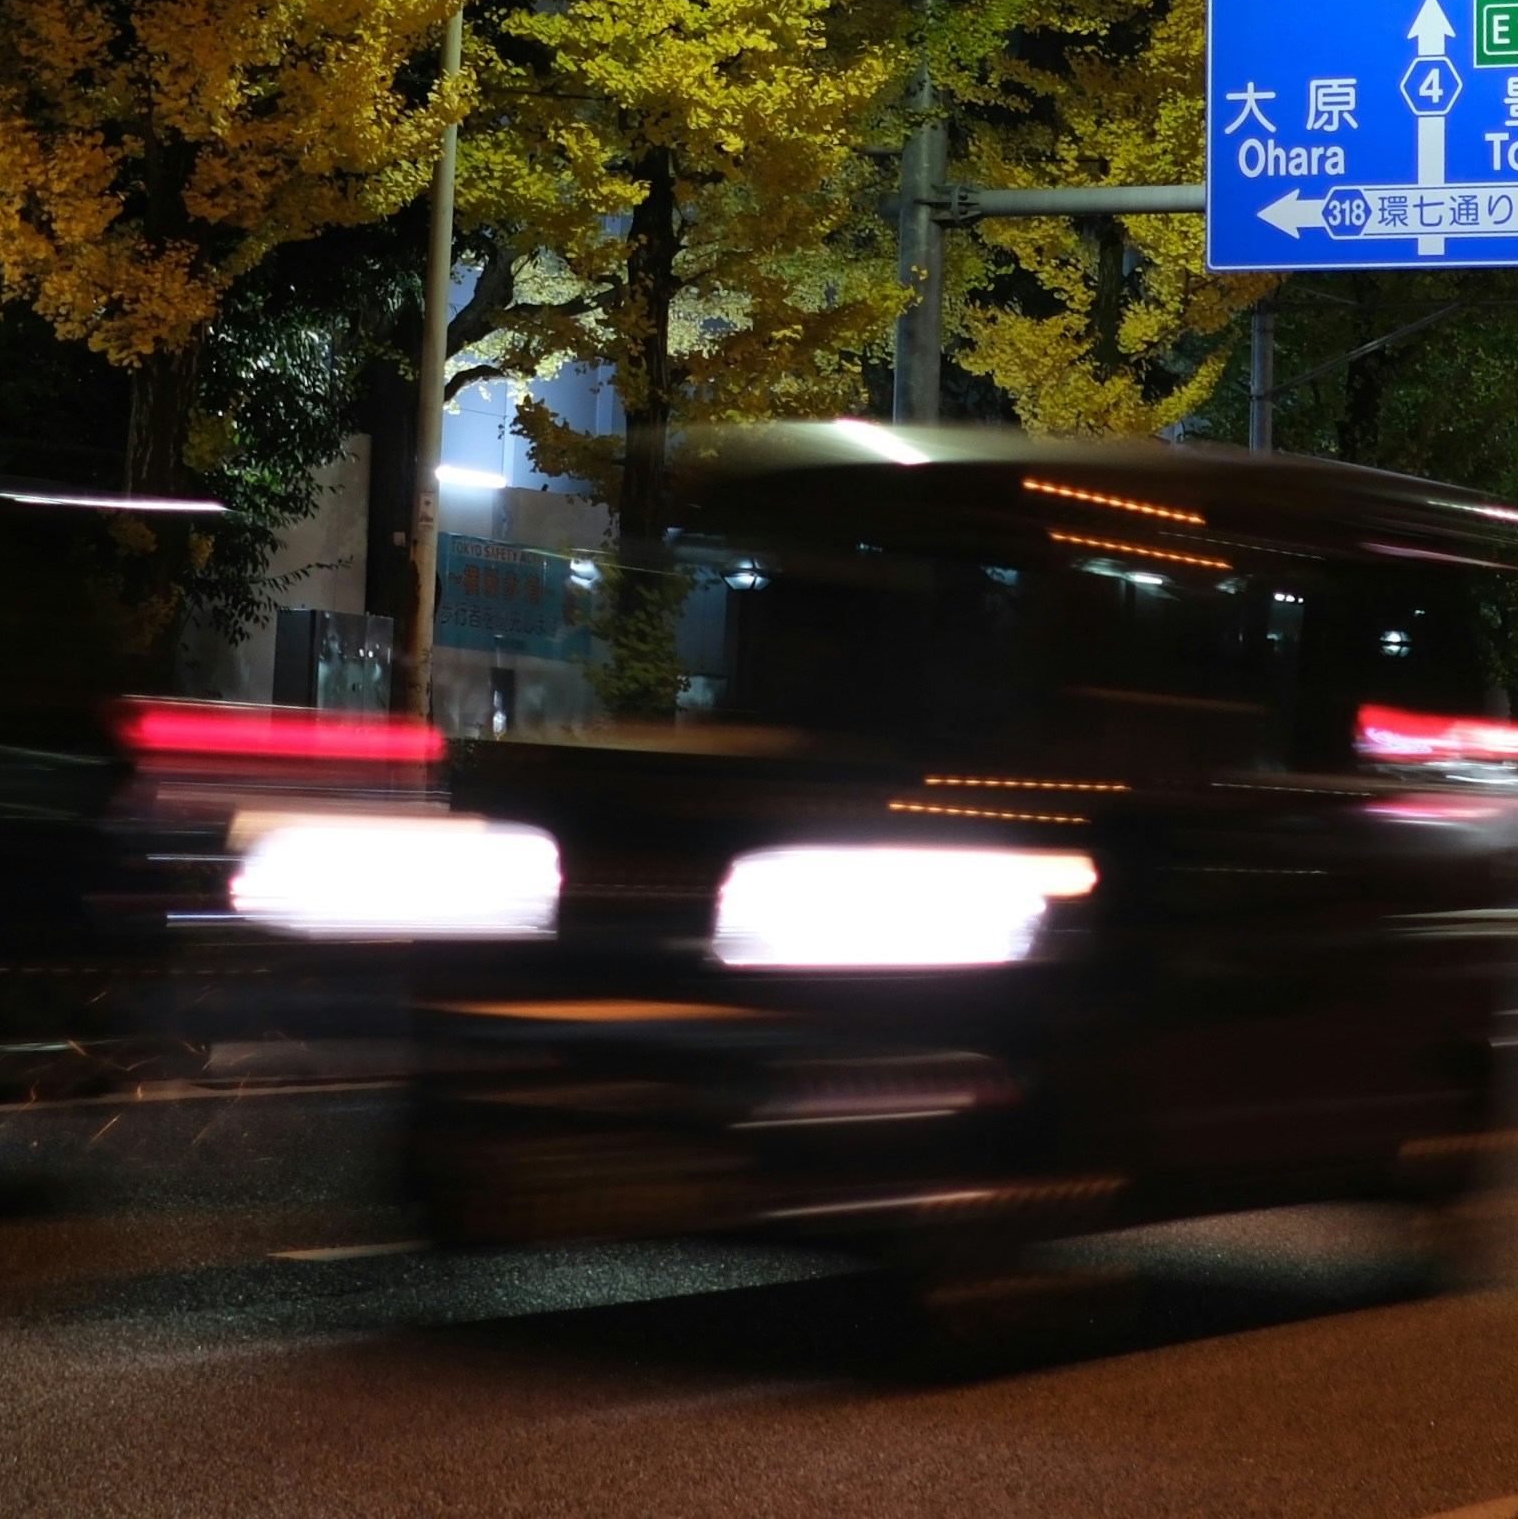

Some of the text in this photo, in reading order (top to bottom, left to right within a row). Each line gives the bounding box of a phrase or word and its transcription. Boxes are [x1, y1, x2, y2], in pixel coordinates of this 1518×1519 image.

[1418, 68, 1444, 103] 4
[1224, 78, 1359, 134] 大原
[1238, 138, 1346, 177] Ohara
[1328, 198, 1365, 227] 318
[1377, 193, 1515, 227] 環七通り
[451, 539, 482, 557] TOKYO
[483, 545, 518, 562] SAFETY
